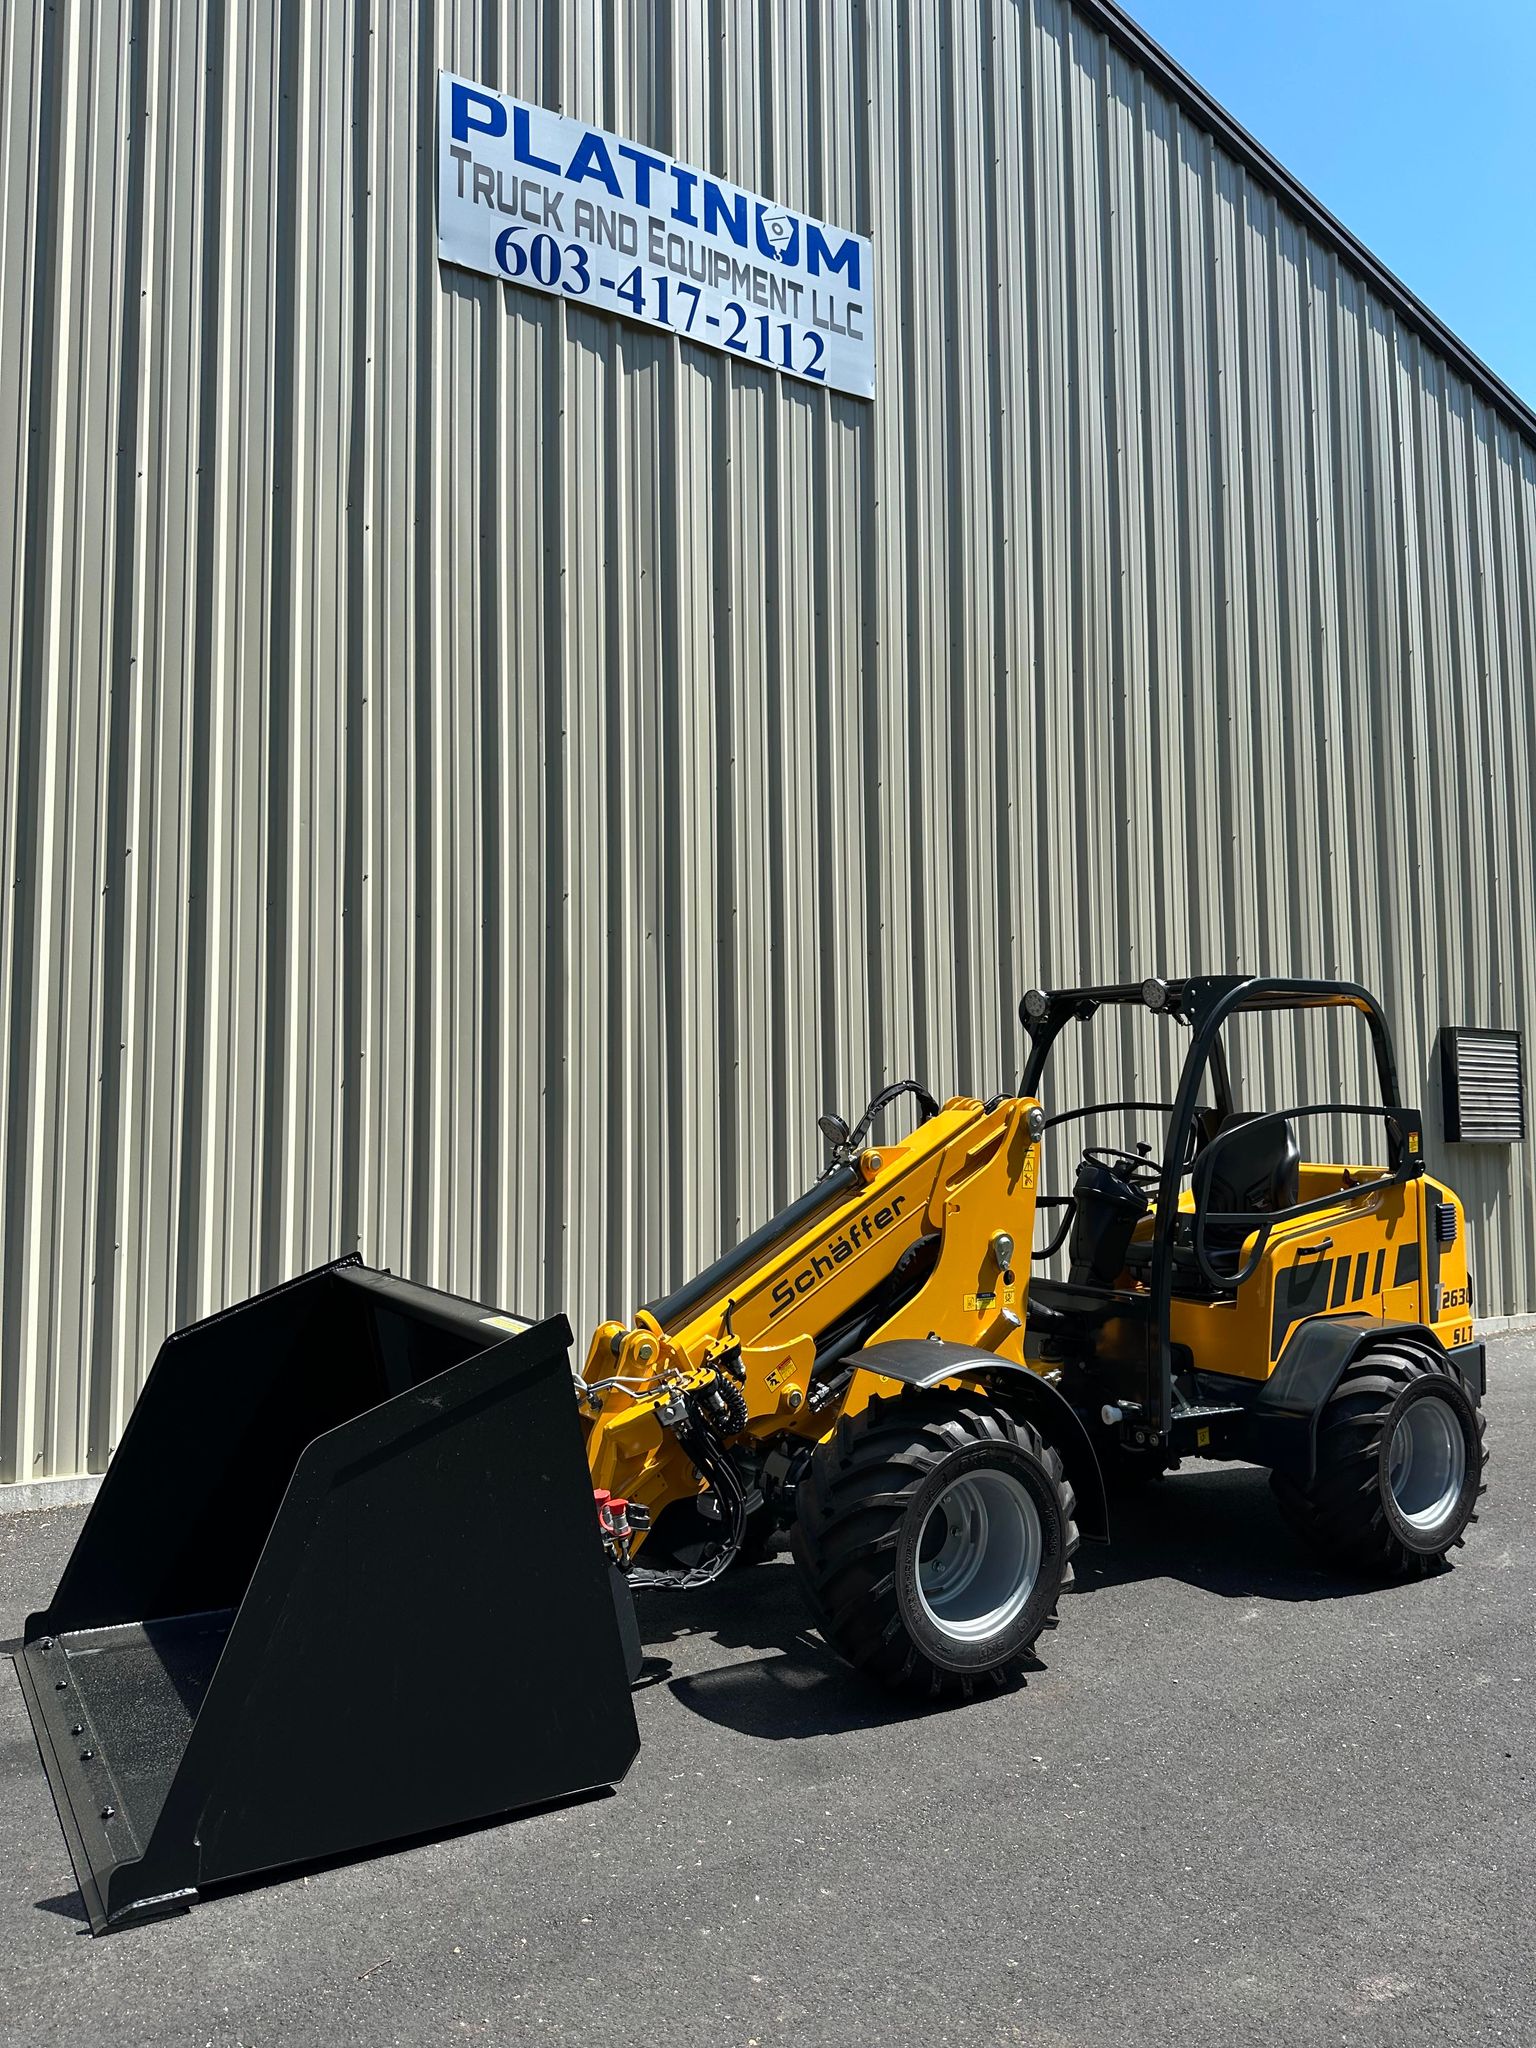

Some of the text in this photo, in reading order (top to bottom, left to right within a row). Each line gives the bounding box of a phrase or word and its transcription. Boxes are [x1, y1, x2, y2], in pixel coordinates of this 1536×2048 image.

[450, 144, 864, 341] TRUCK AND EQUIPMENT LLC
[451, 81, 861, 291] PLATINUM
[494, 226, 827, 380] 603-417-2112
[768, 1195, 906, 1319] Schäffer
[1453, 1325, 1473, 1345] SLT
